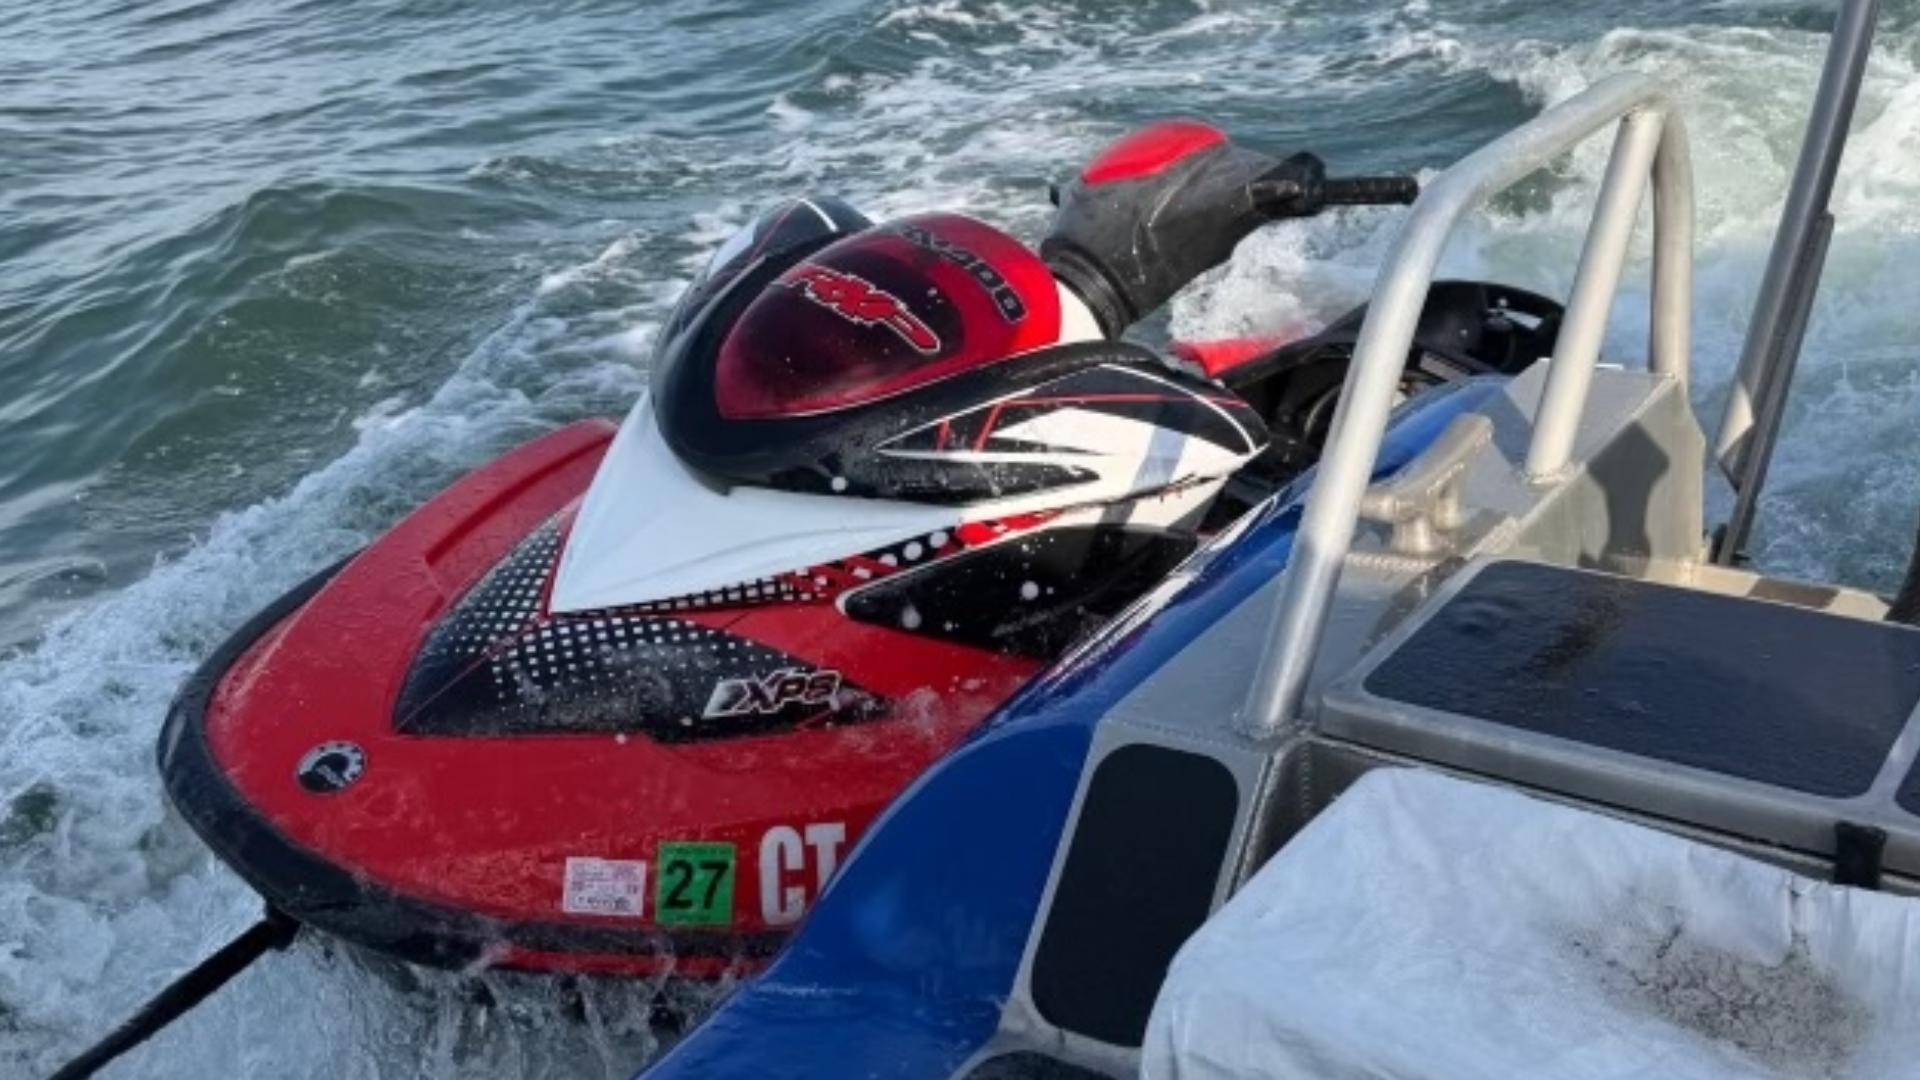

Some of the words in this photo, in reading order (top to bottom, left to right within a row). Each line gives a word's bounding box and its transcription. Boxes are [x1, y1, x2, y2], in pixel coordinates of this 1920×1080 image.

[733, 667, 843, 715] XPS
[662, 859, 729, 910] 27
[759, 822, 847, 926] CT
